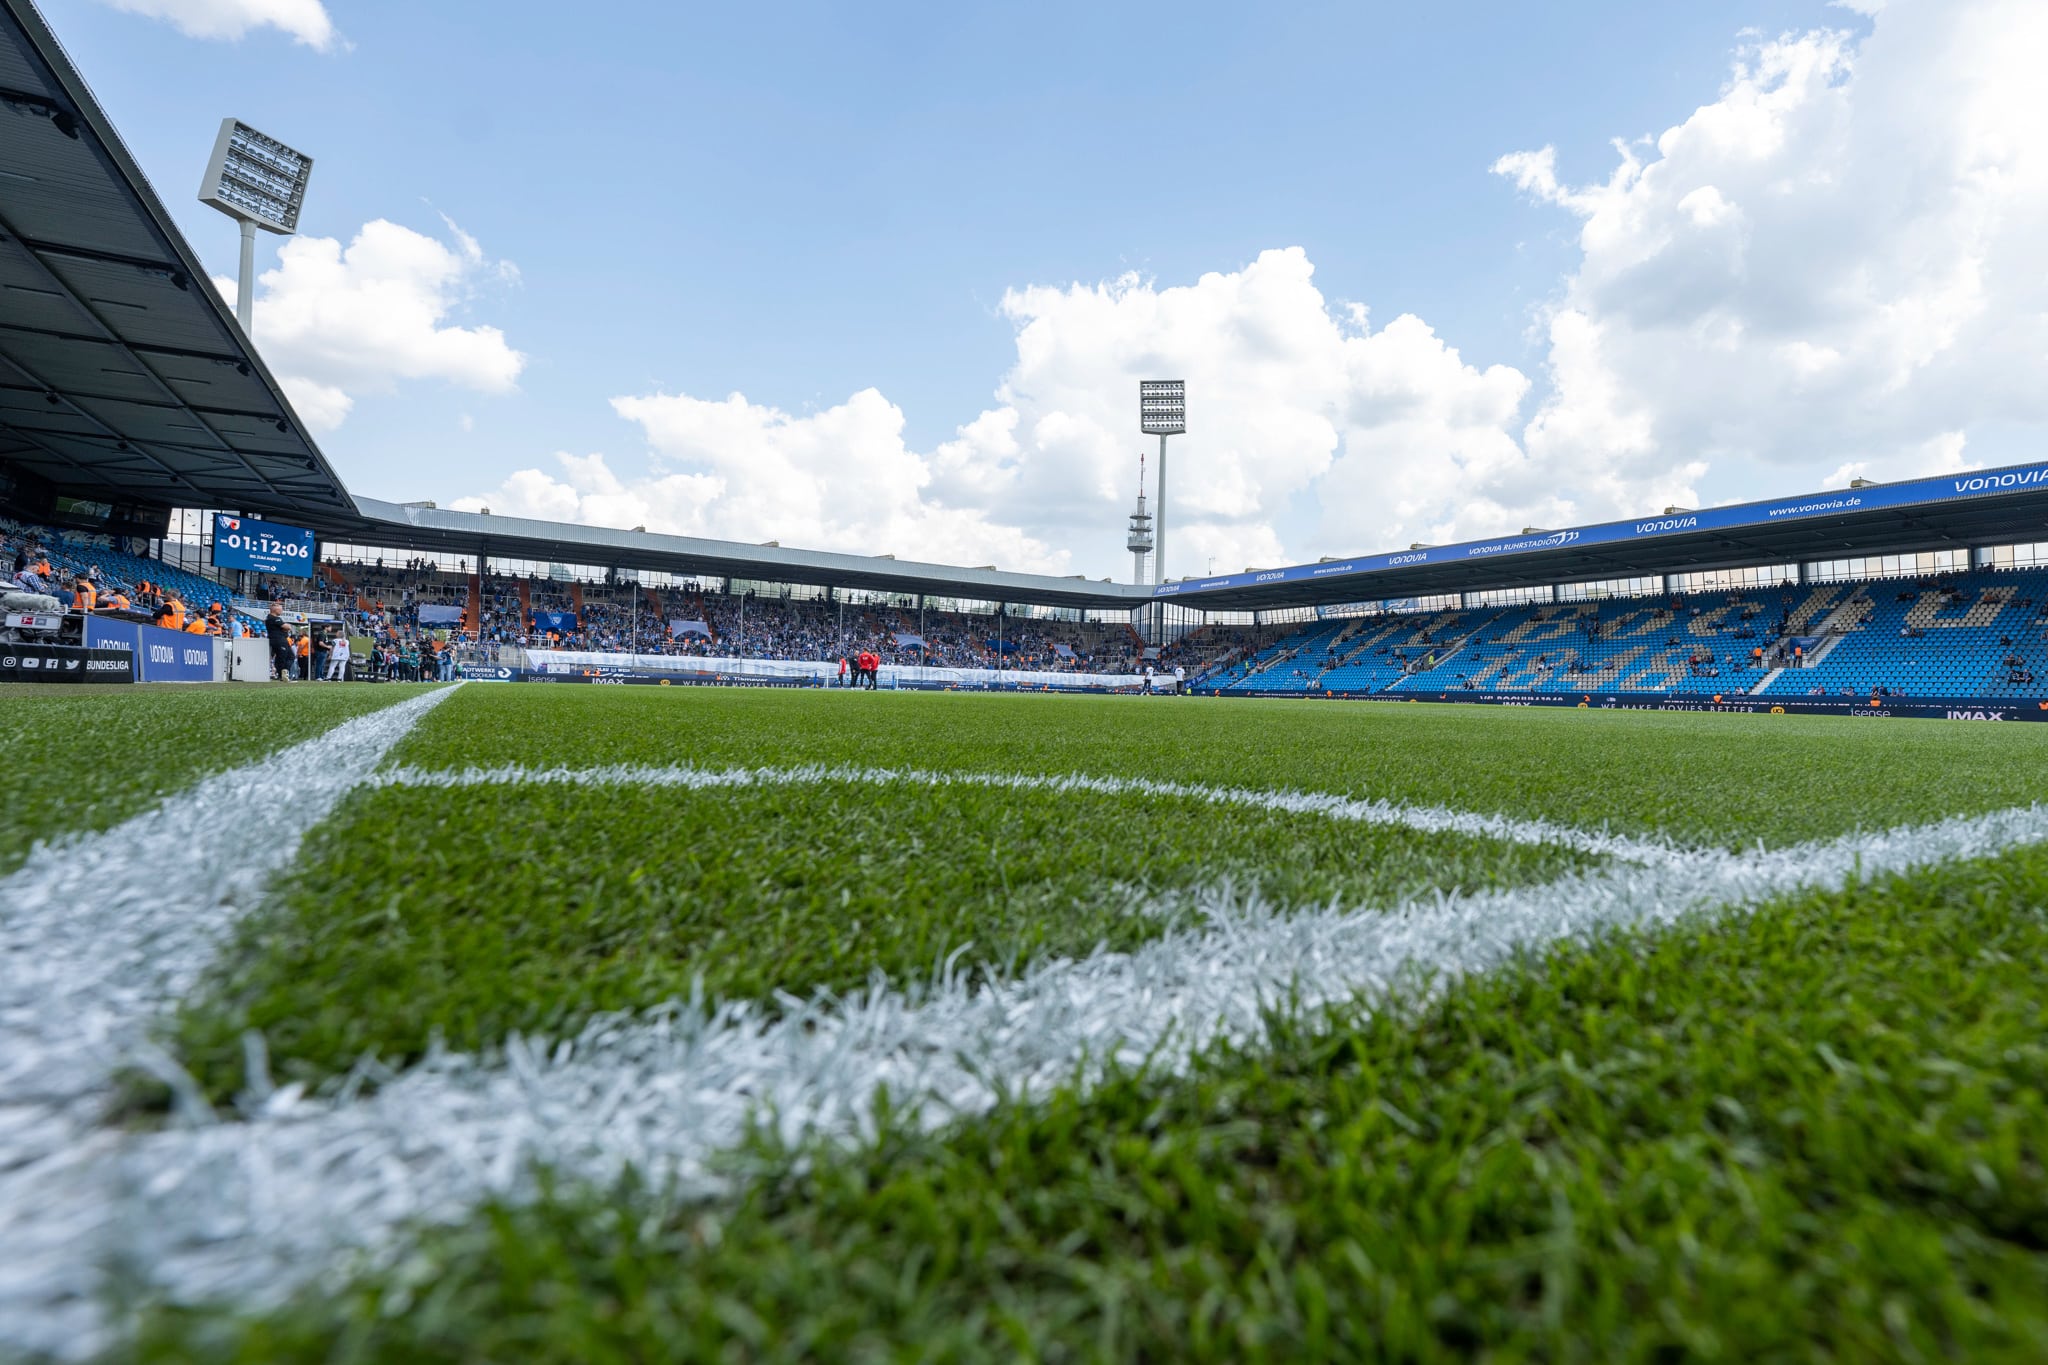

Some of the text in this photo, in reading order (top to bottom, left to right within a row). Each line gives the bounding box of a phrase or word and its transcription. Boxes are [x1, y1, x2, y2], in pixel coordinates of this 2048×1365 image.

[1769, 497, 1862, 517] www.vonovia.de
[1635, 516, 1697, 533] VONOVIA
[220, 534, 308, 558] -01:12:06
[1468, 538, 1558, 555] VONOVIA RUHRSTADION
[1389, 552, 1427, 565] VONOVIA
[1256, 571, 1285, 582] VONOVIA
[1313, 564, 1353, 575] www.vonovia.de
[149, 644, 174, 663] VONOVIA
[183, 648, 208, 665] VONOVIA
[86, 660, 129, 670] BUNDESLIGA
[1851, 708, 1891, 717] isense
[1947, 710, 2004, 721] IMAX
